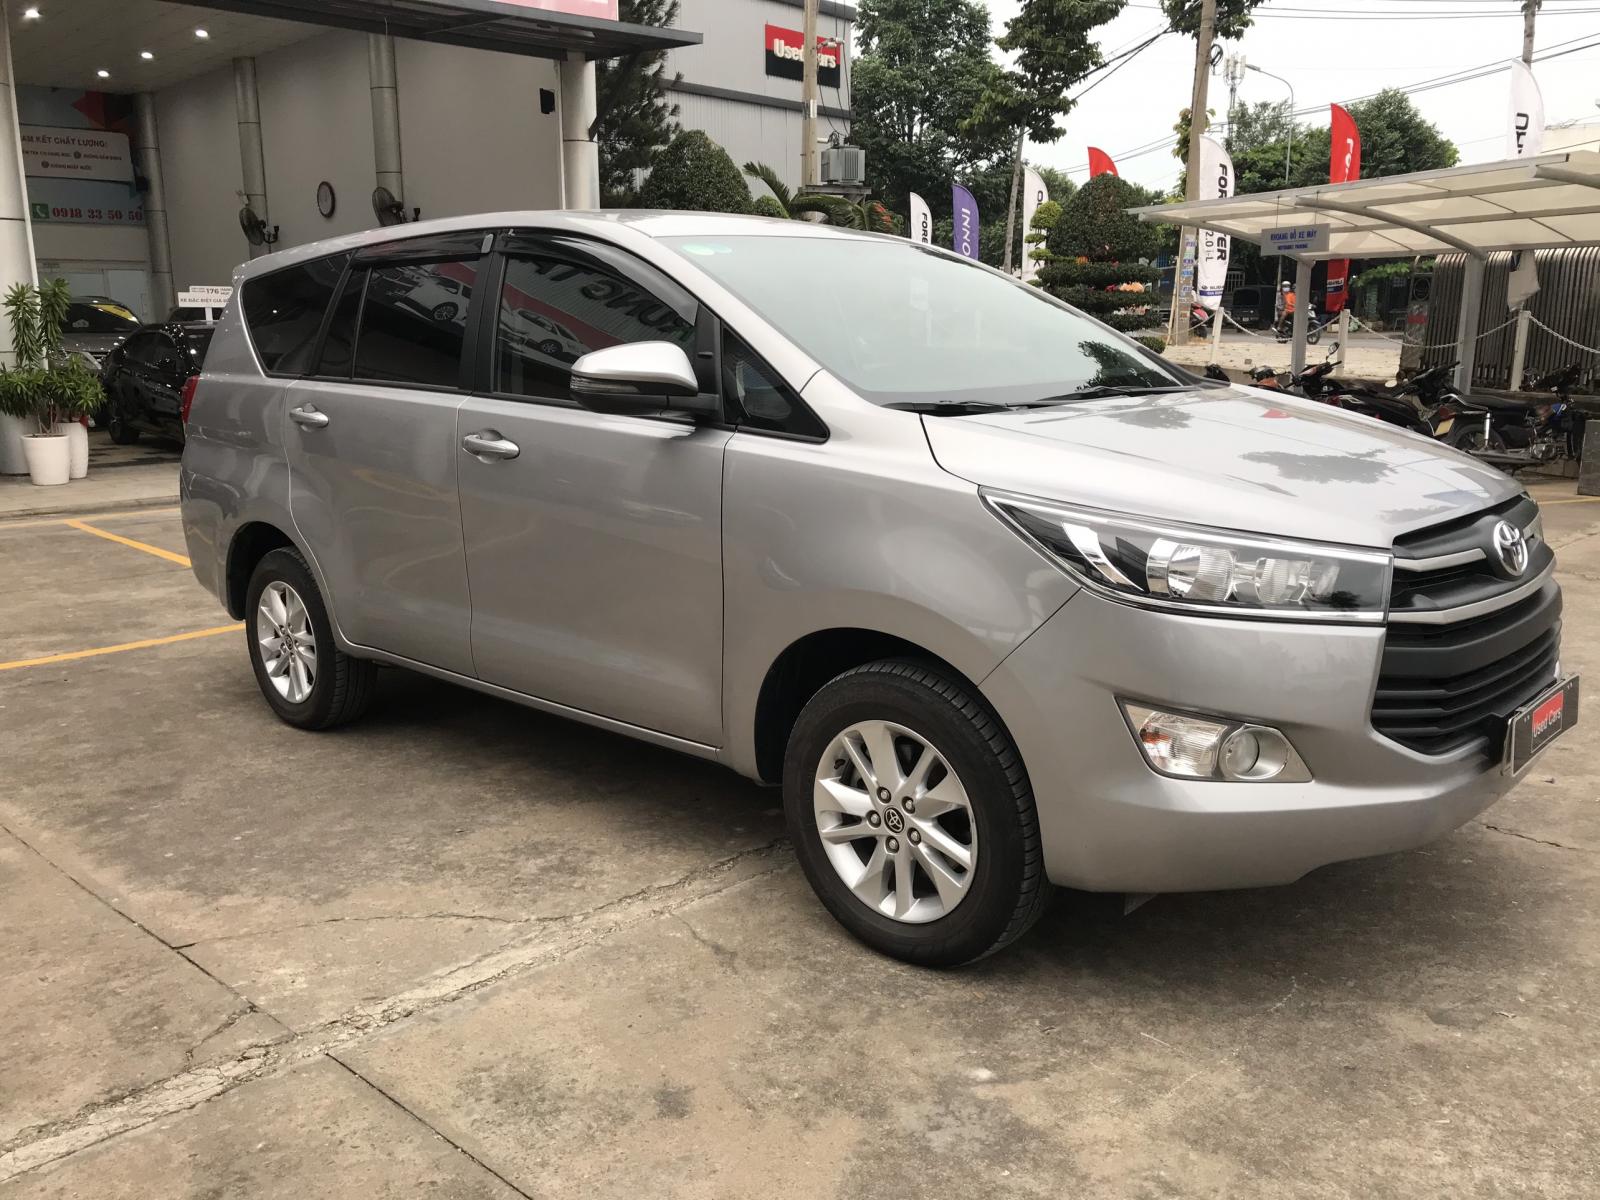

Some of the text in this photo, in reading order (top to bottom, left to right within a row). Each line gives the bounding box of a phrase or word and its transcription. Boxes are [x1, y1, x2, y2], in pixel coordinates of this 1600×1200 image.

[961, 207, 971, 257] INNO
[1534, 709, 1561, 738] Used Cars
